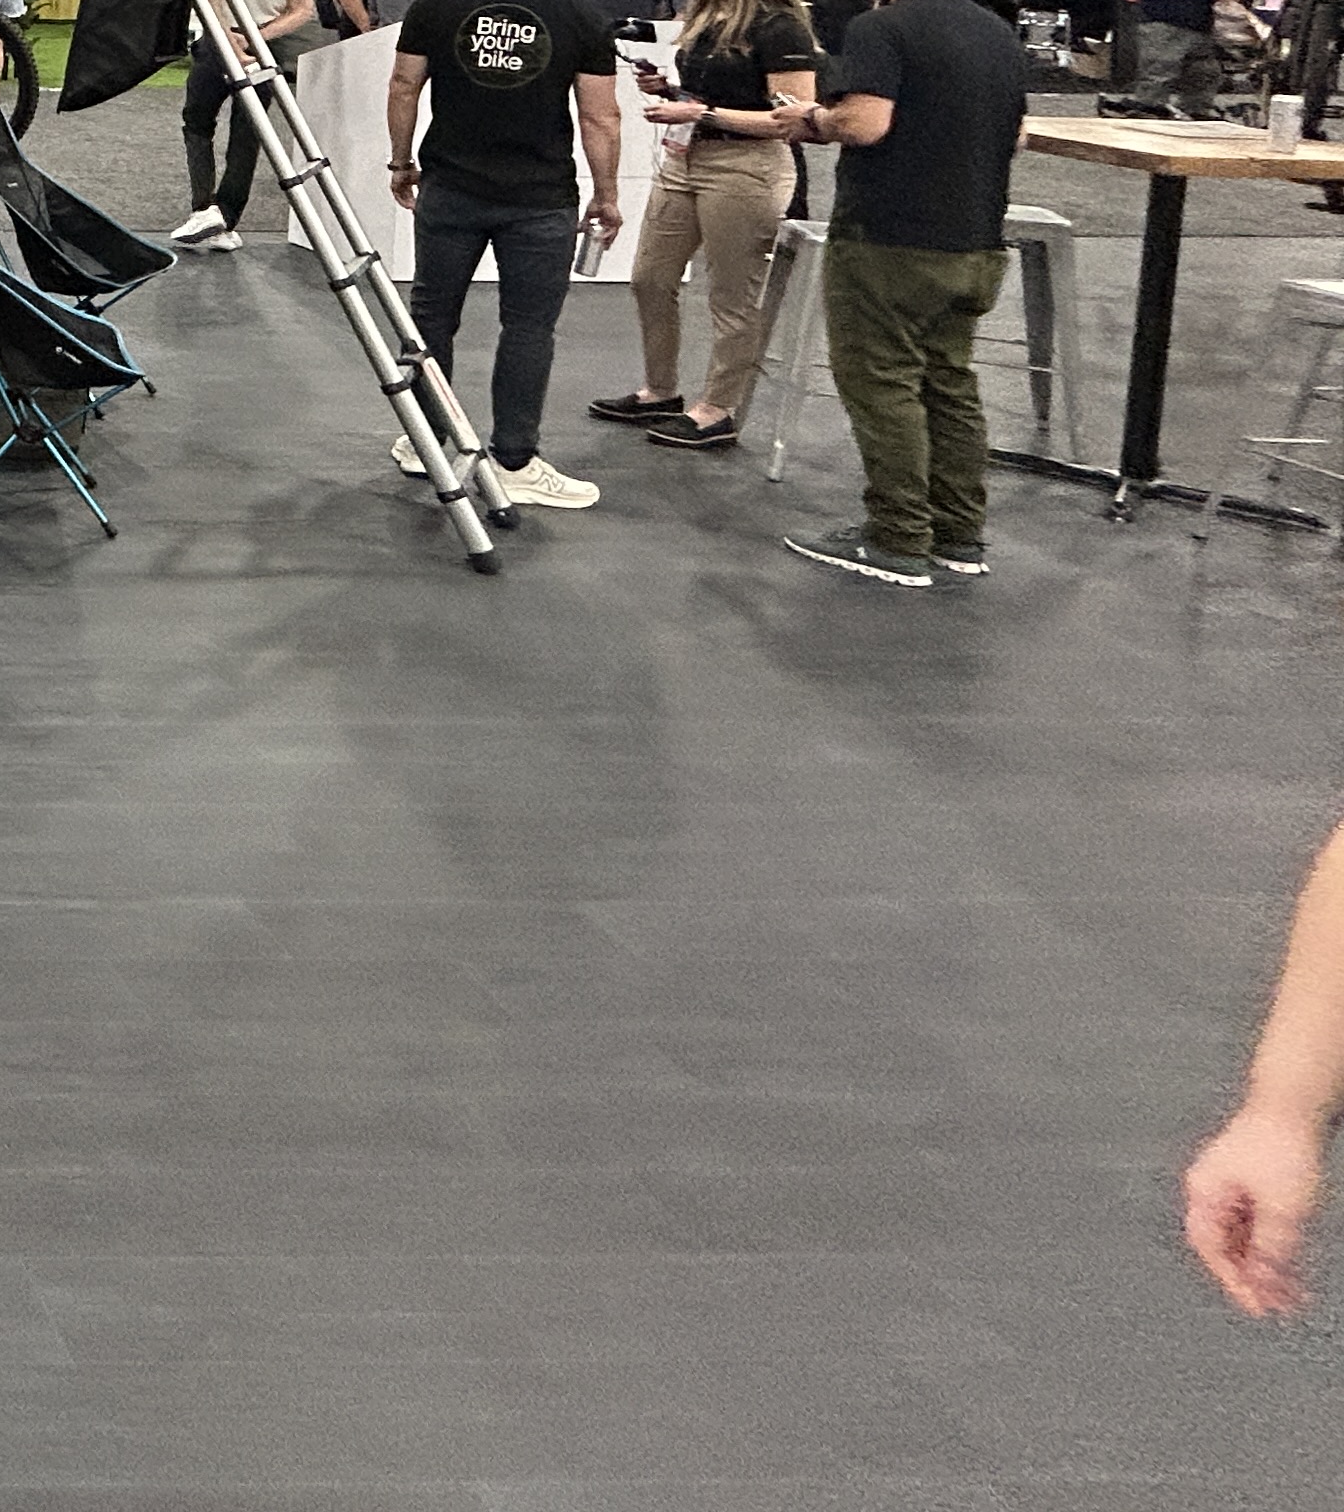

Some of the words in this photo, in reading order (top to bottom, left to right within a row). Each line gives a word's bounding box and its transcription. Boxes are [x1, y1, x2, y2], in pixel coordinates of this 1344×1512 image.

[477, 16, 537, 44] Bring
[470, 35, 520, 53] your
[478, 50, 523, 72] bike
